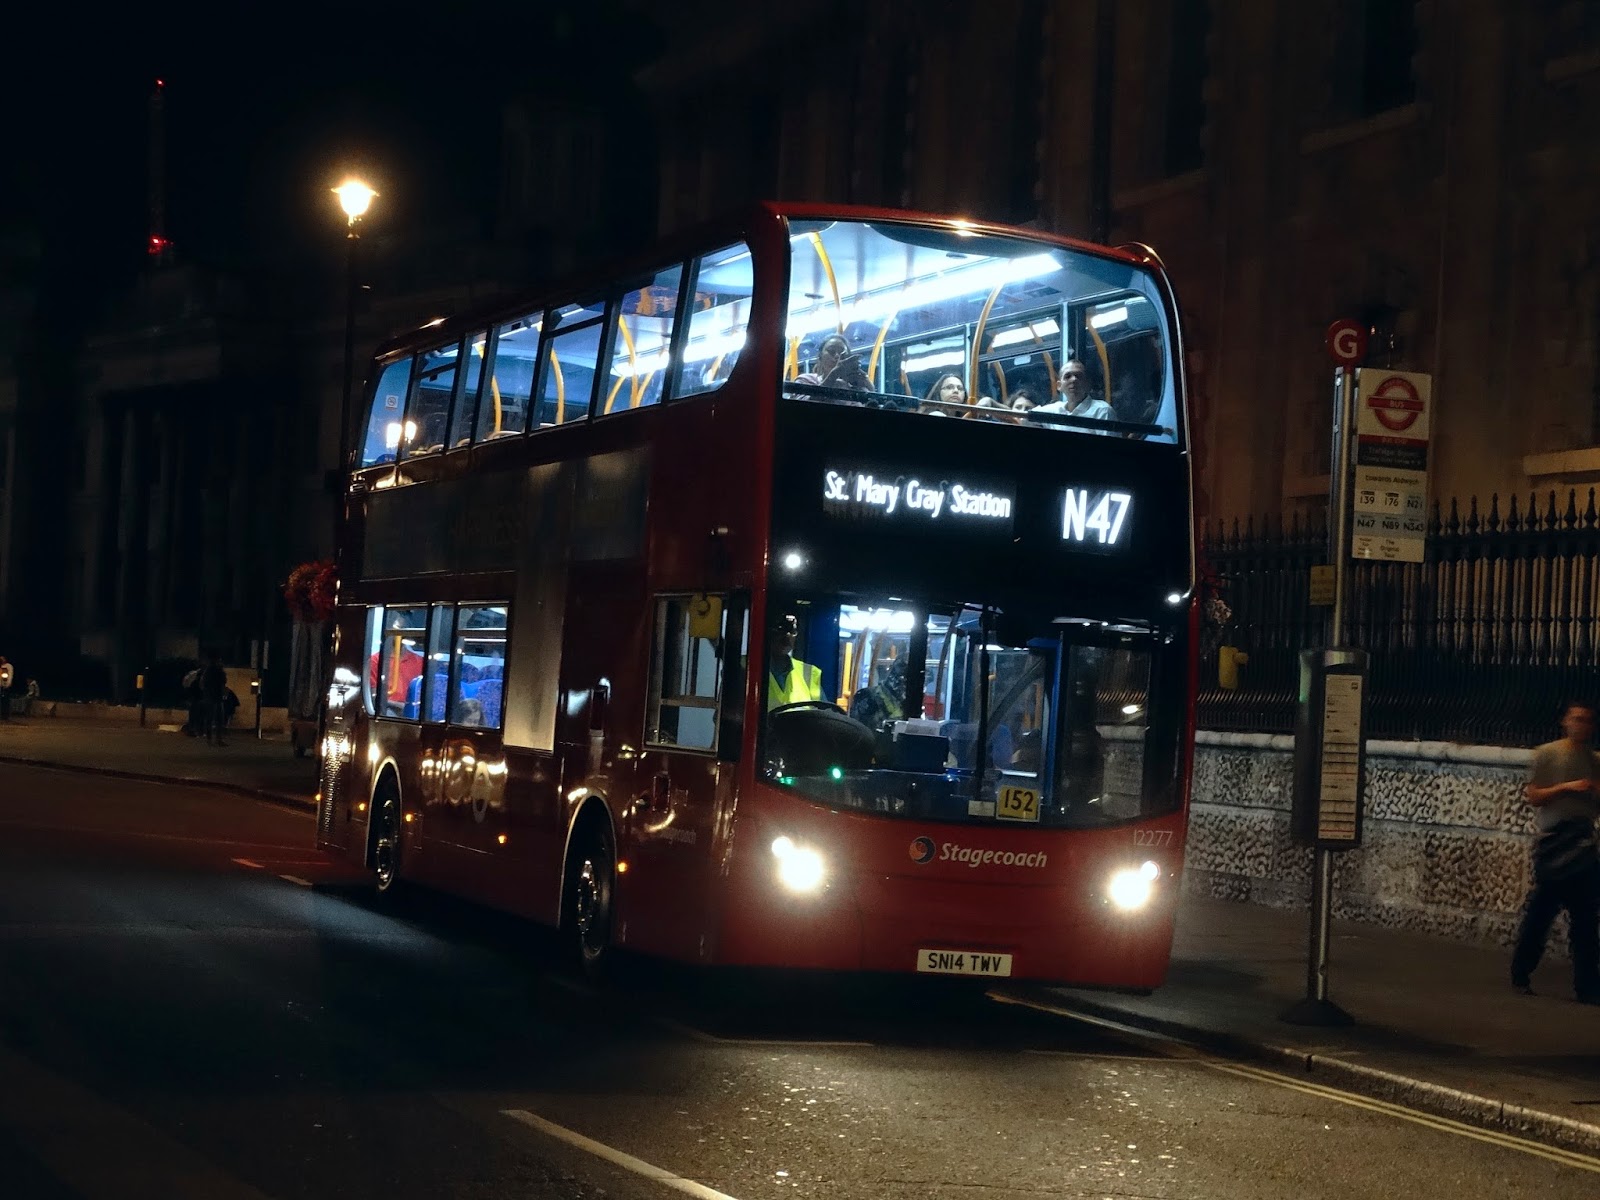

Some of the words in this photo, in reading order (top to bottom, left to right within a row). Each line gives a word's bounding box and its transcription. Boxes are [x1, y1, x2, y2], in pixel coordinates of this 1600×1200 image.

[1333, 328, 1358, 359] G
[1389, 400, 1405, 409] BUS
[824, 471, 850, 501] St.
[856, 474, 899, 514] Mary
[906, 479, 944, 518] Cray
[949, 484, 1011, 518] Station
[1360, 496, 1375, 505] 139
[1384, 497, 1399, 507] 176
[1062, 488, 1132, 544] N47
[1357, 519, 1375, 528] N47
[1382, 520, 1400, 530] N89
[1004, 789, 1034, 812] 152
[1133, 829, 1173, 847] 12277
[938, 842, 1048, 868] Stagecoach
[928, 952, 964, 971] SN14
[971, 955, 1002, 973] TWV
